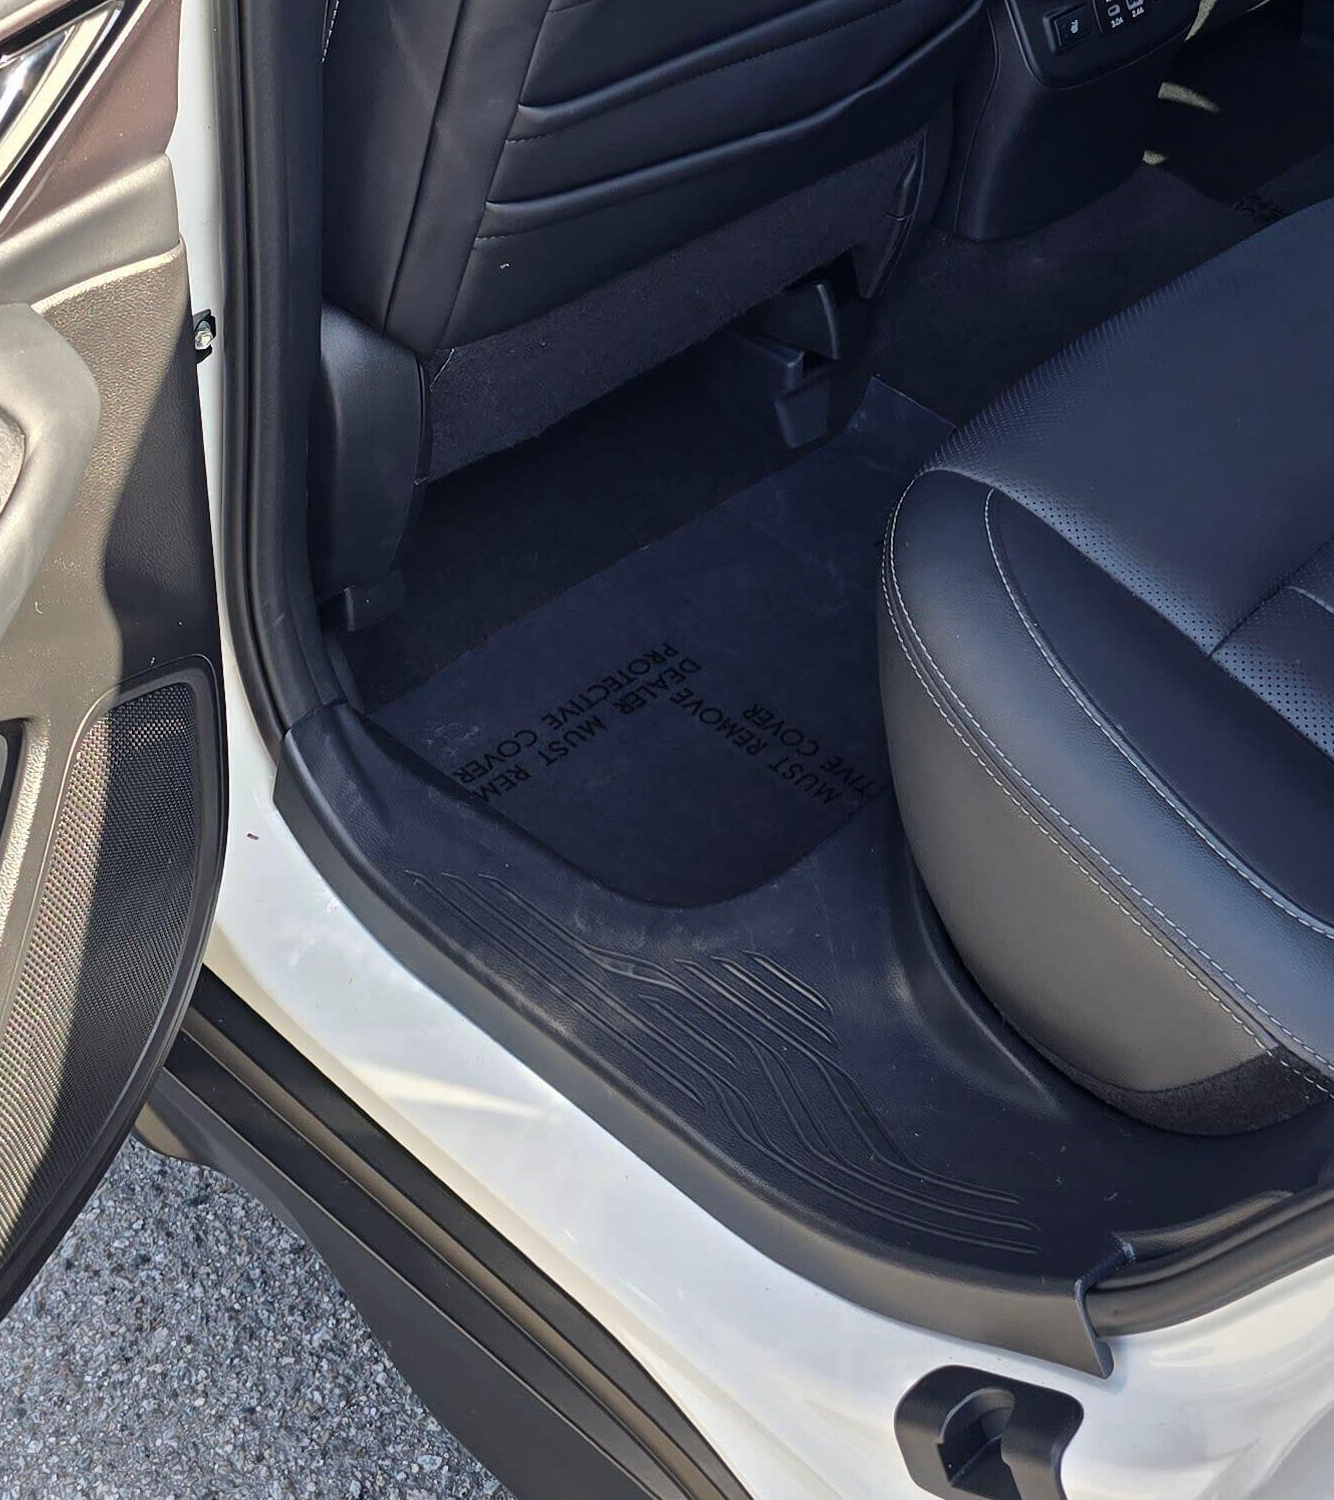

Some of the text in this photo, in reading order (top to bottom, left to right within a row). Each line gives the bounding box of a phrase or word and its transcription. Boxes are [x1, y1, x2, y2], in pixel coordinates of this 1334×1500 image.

[455, 642, 679, 786] PROTECTIVE COVER
[467, 656, 703, 804] DEALER MUST REM
[669, 687, 843, 805] MUST REMOVE
[742, 702, 821, 758] COVER
